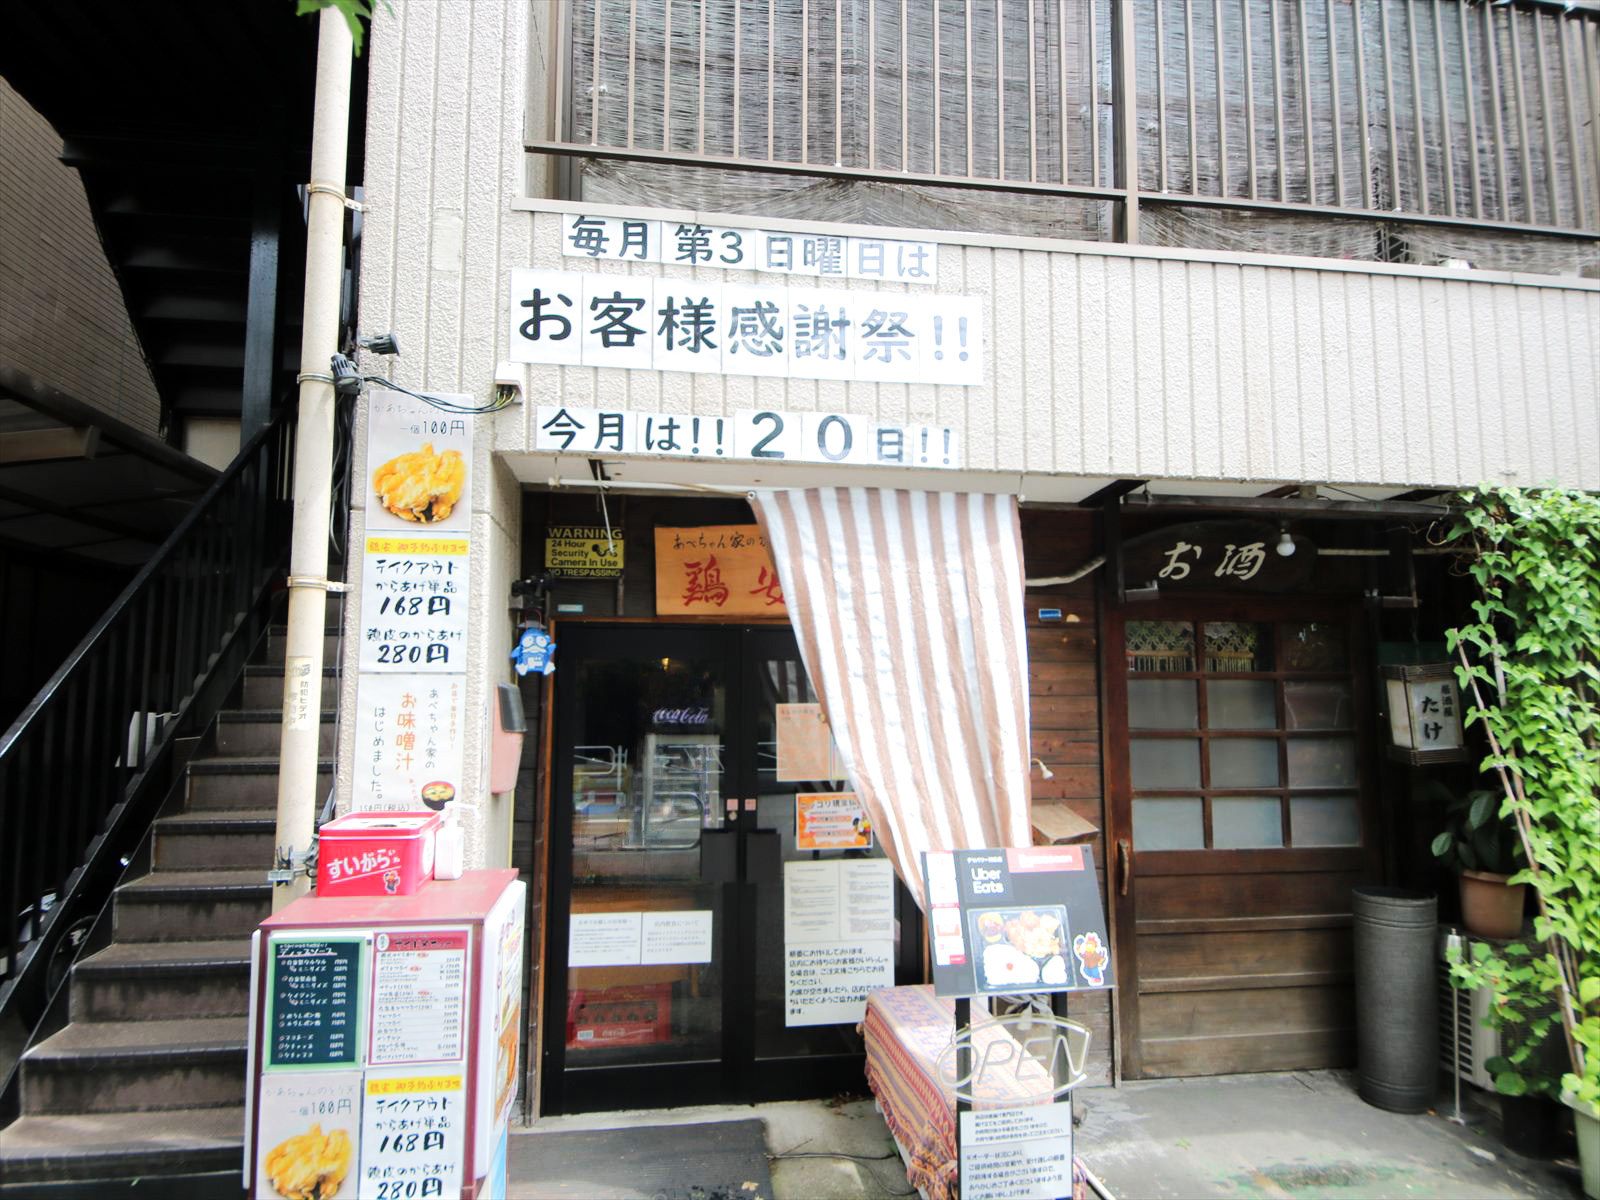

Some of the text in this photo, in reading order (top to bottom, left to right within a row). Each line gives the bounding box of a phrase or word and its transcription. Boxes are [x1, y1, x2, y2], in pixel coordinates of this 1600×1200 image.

[548, 528, 623, 539] WARNING
[552, 540, 586, 548] 24 Hour
[551, 549, 589, 558] Security
[552, 558, 618, 567] Camera In Use
[376, 559, 459, 575] テイクアウト
[563, 568, 622, 577] TRESPASSING
[379, 595, 451, 616] 168円
[377, 643, 449, 663] 280円
[1421, 696, 1444, 741] たけ
[395, 692, 417, 771] お味噌汁
[370, 706, 387, 800] はじめました。
[971, 867, 1001, 881] Uber
[973, 881, 1004, 894] Eats
[936, 1033, 1092, 1088] OPEN
[376, 1096, 453, 1114] テイクアウト
[379, 1131, 444, 1153] 168円
[376, 1178, 443, 1200] 280円
